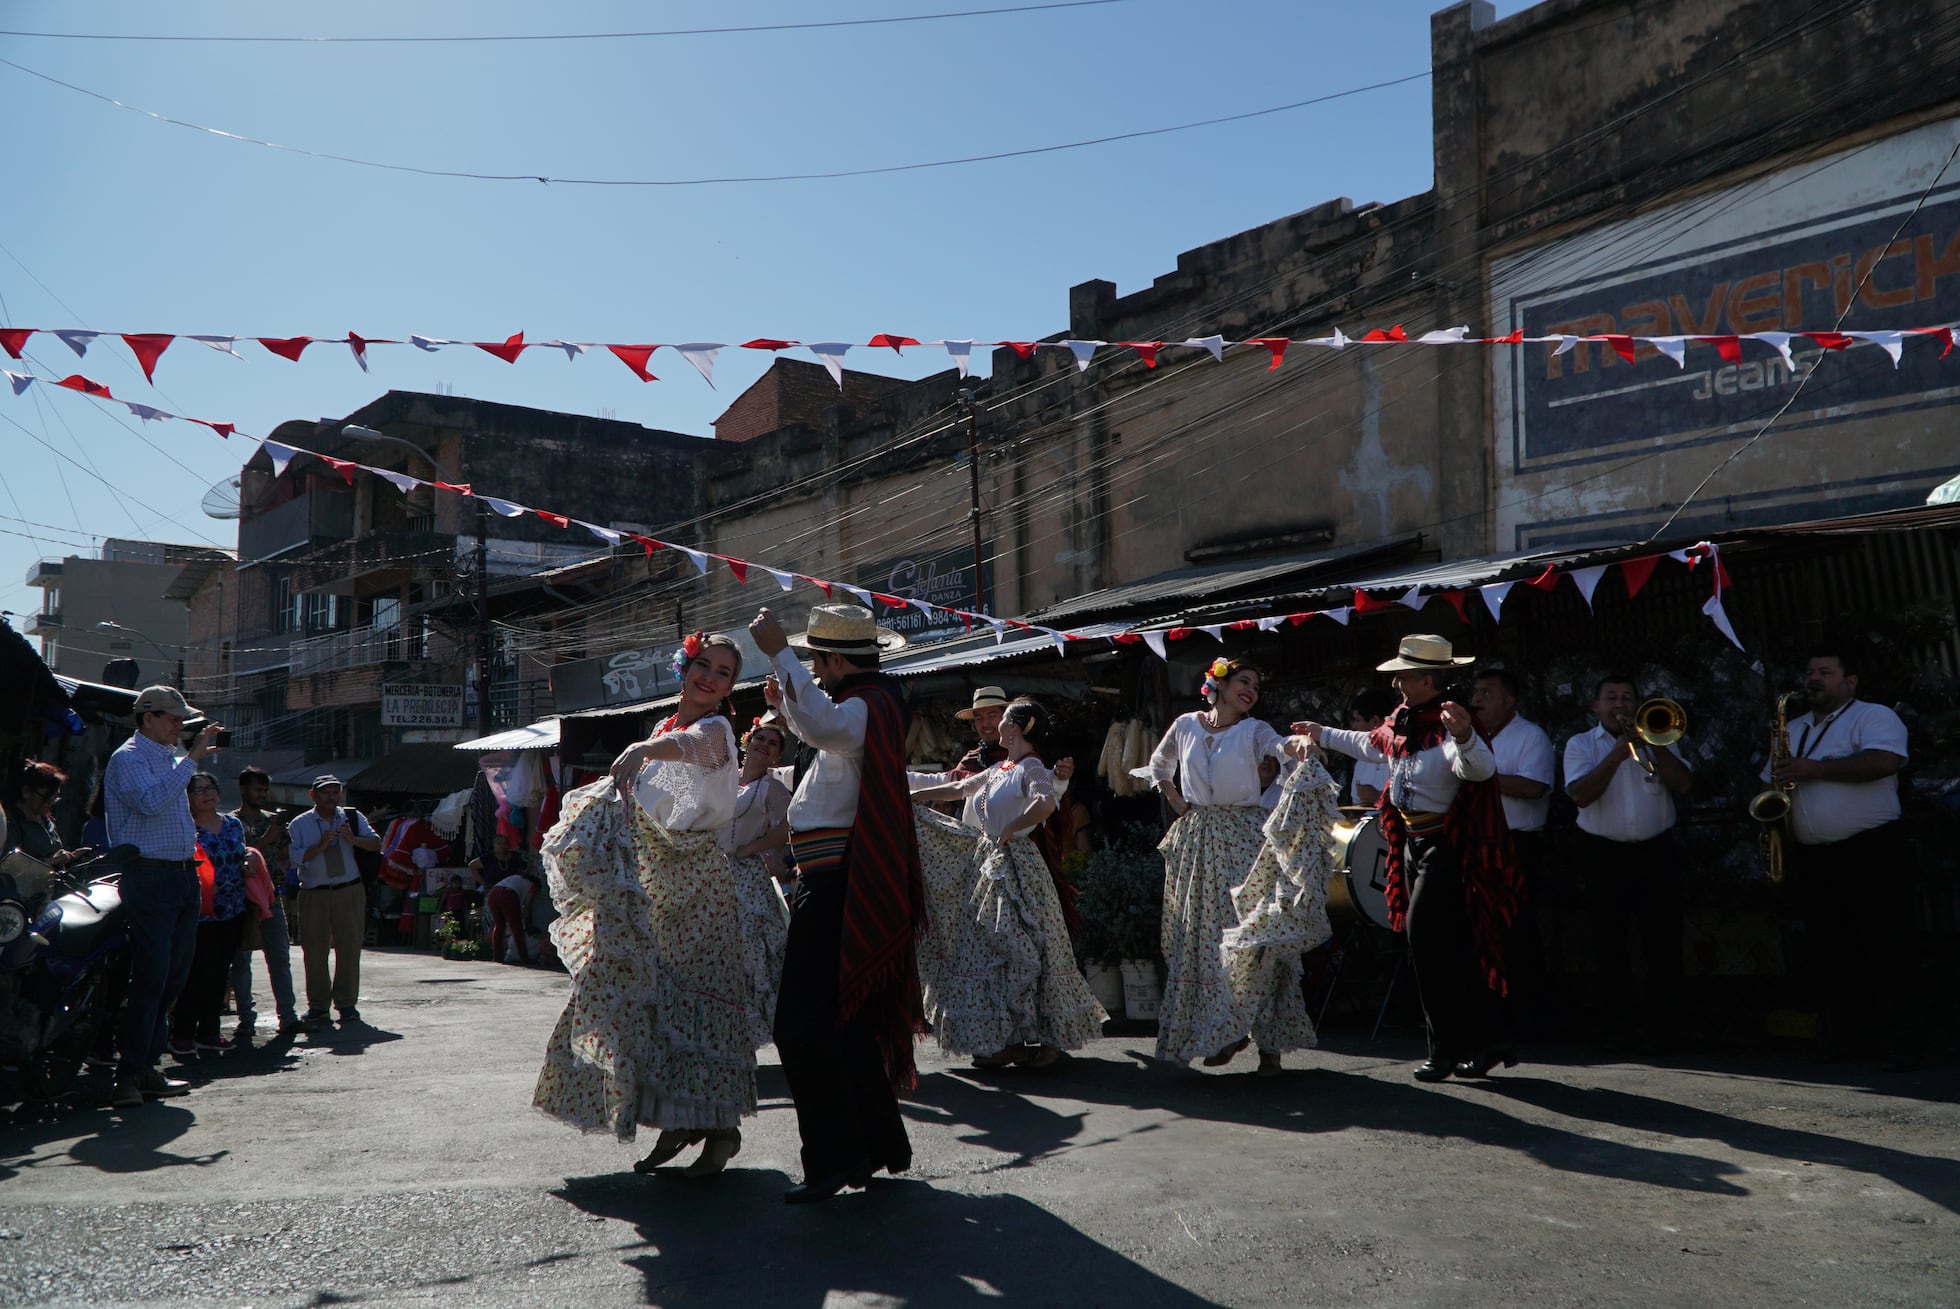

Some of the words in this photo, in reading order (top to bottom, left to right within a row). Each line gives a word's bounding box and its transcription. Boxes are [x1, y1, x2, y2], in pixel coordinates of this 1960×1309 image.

[931, 590, 962, 602] DANZA
[386, 698, 399, 713] LA
[403, 698, 459, 715] PREDILECTA
